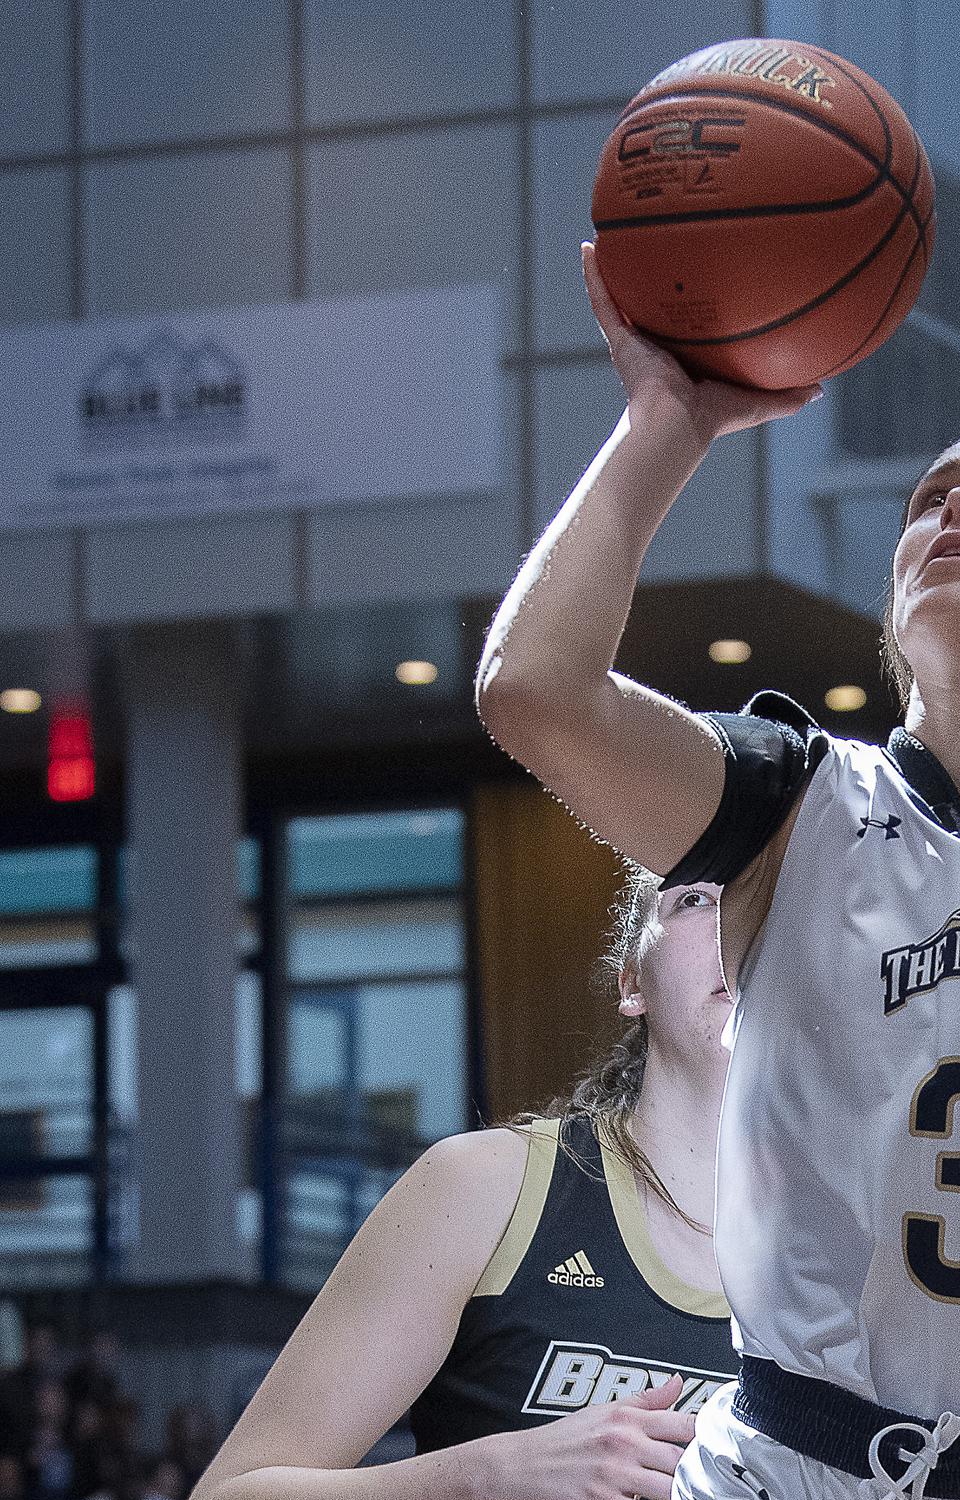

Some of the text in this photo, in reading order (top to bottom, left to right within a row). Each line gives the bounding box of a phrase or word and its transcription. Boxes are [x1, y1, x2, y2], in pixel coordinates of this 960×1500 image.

[886, 941, 946, 1005] THE
[547, 1270, 605, 1288] adidas
[536, 1350, 728, 1417] BRYA
